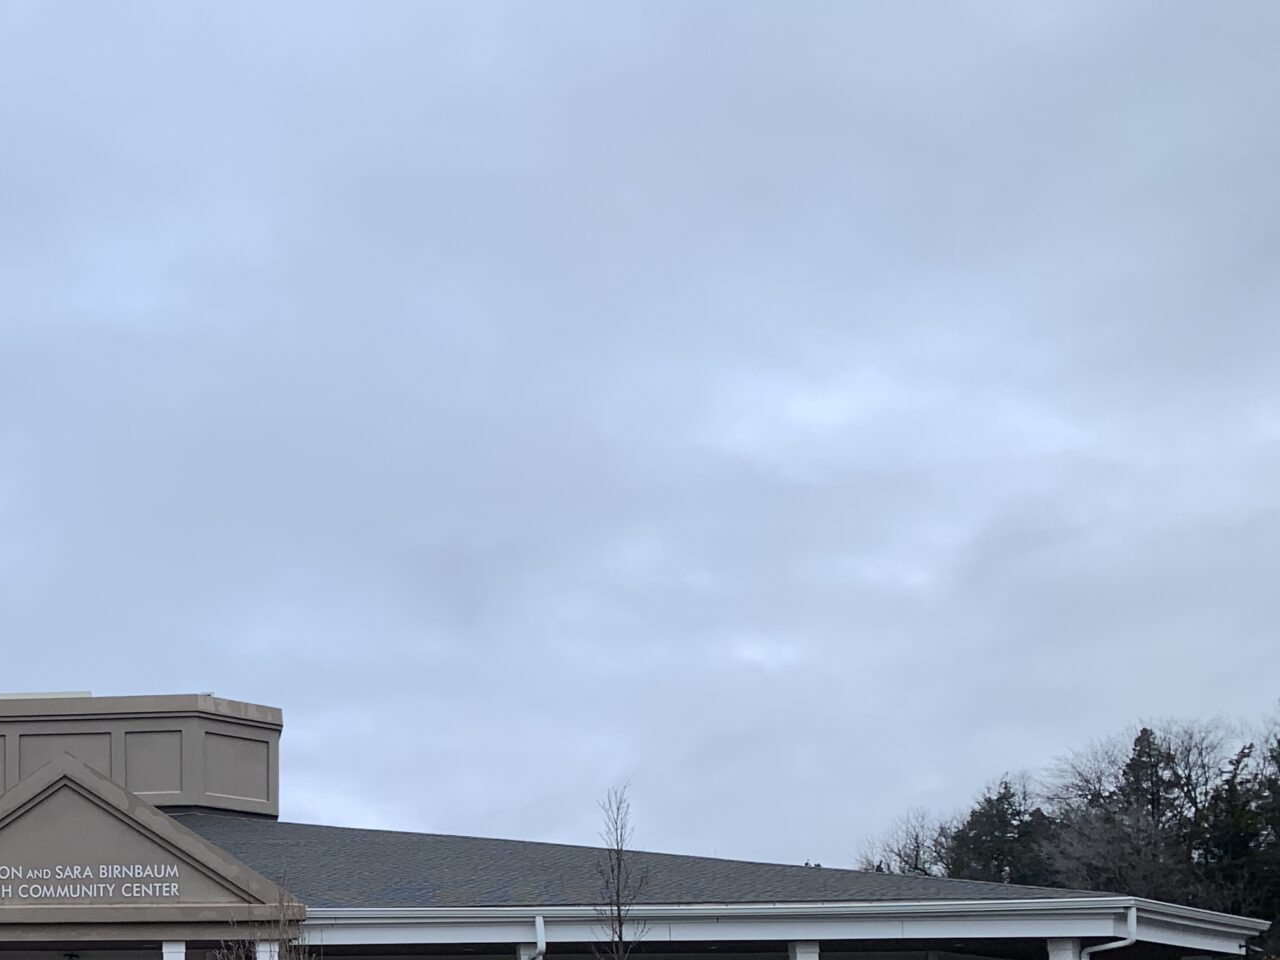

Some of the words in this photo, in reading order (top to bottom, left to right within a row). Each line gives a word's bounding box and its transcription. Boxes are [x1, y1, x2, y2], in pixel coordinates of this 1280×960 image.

[26, 869, 51, 879] AND
[55, 865, 94, 879] SARA
[99, 864, 180, 878] BIRNBAUM
[18, 883, 116, 898] COMMUNITY
[121, 883, 180, 897] CENTER
